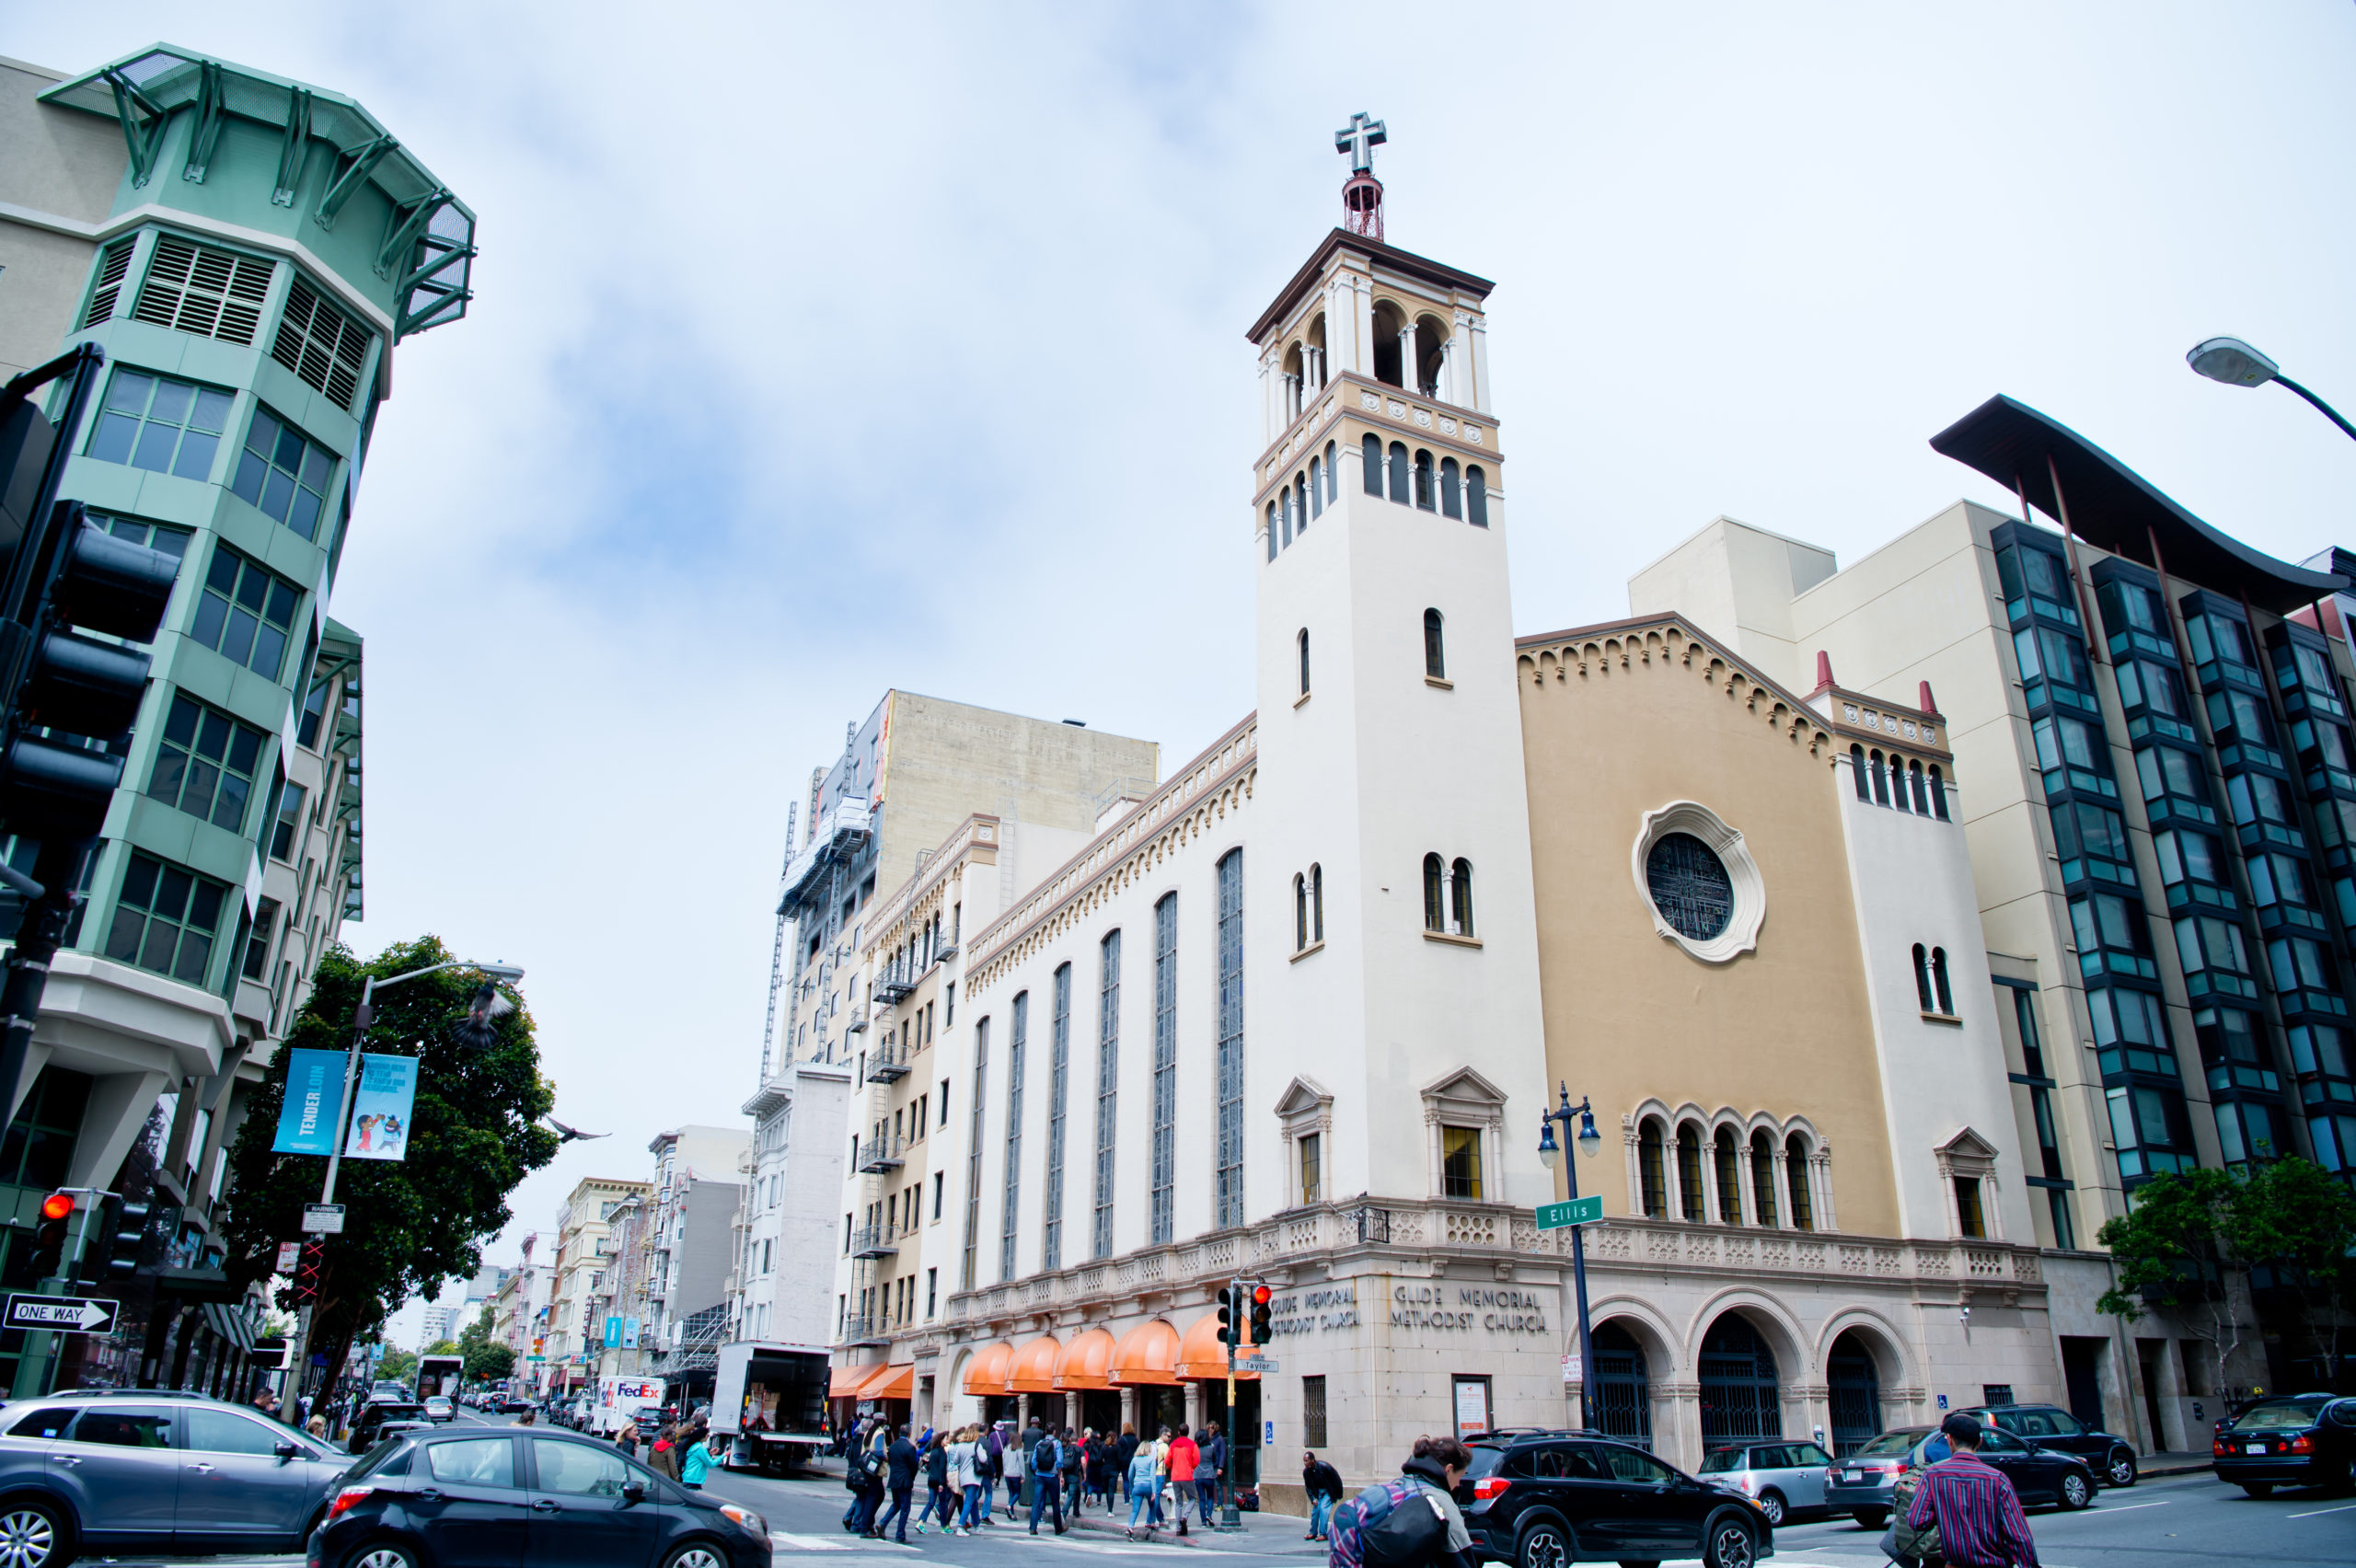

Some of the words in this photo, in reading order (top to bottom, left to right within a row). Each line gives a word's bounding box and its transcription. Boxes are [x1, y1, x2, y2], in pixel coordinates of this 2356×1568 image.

[298, 1066, 325, 1136] TENDERLOIN
[1551, 1205, 1588, 1222] Ellis
[1271, 1296, 1298, 1314] GLIDE
[1305, 1286, 1357, 1309] MEMORIAL
[1394, 1286, 1442, 1305] GLIDE
[1459, 1288, 1541, 1309] MEMORIAL
[18, 1305, 49, 1319] ONE
[54, 1308, 85, 1321] WAY
[1320, 1310, 1360, 1332] CHURCH
[1391, 1309, 1473, 1328] METHODIST
[1484, 1313, 1546, 1332] CHURCH
[1245, 1362, 1270, 1371] Taylor
[618, 1383, 660, 1398] FedEx
